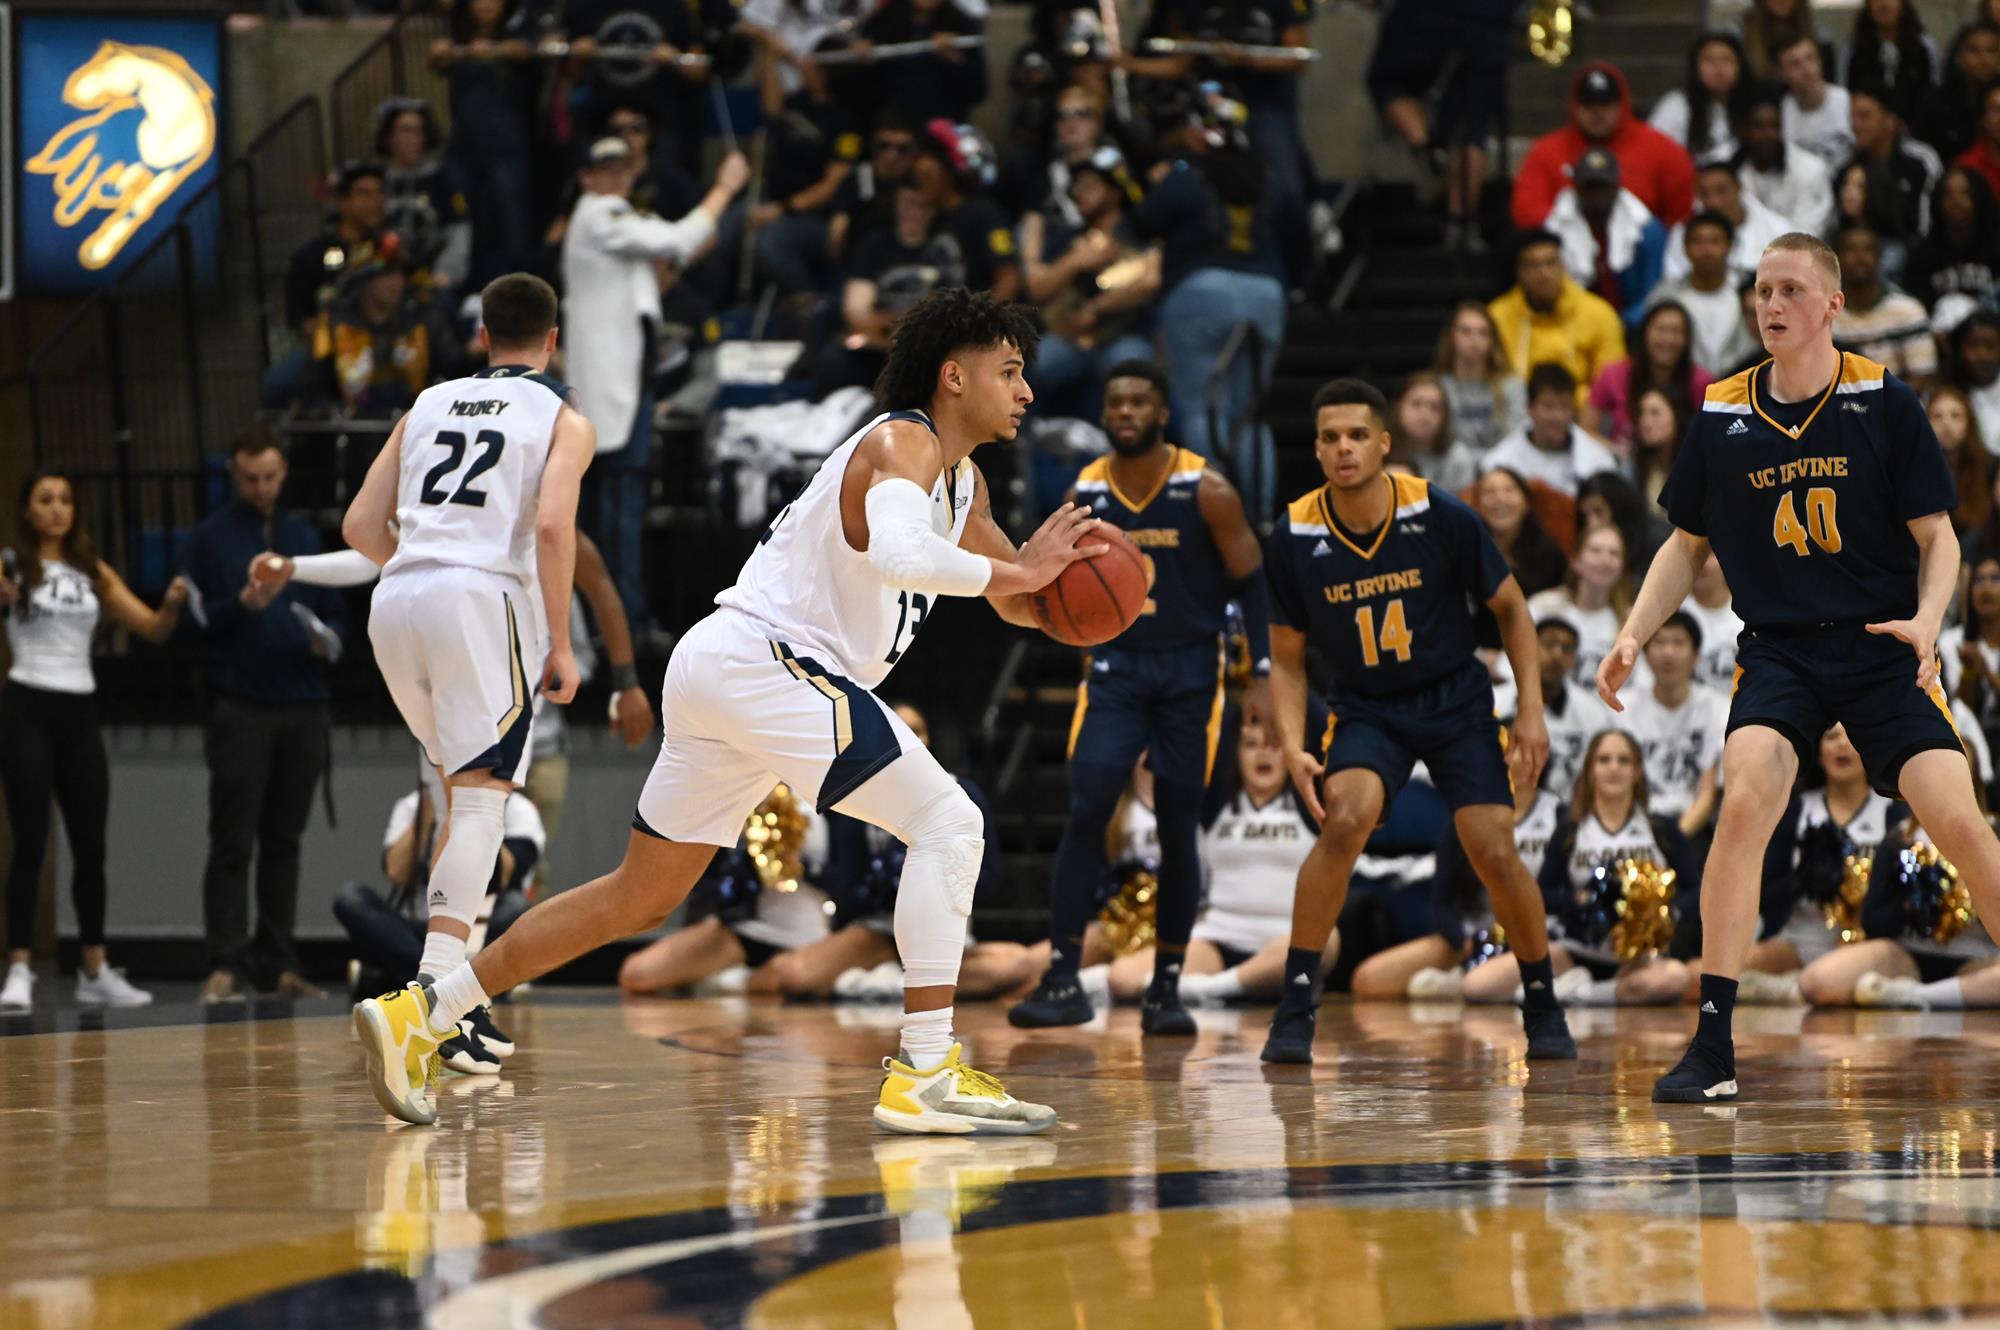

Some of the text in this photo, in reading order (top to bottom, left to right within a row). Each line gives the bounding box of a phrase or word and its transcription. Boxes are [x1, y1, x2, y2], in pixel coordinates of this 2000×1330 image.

[447, 399, 510, 417] MOONEY
[420, 429, 505, 507] 22
[1748, 457, 1848, 489] UC IRVINE
[1773, 487, 1842, 556] 40
[1324, 568, 1422, 603] UC IRVINE
[884, 590, 928, 664] 13
[1355, 598, 1413, 666] 14
